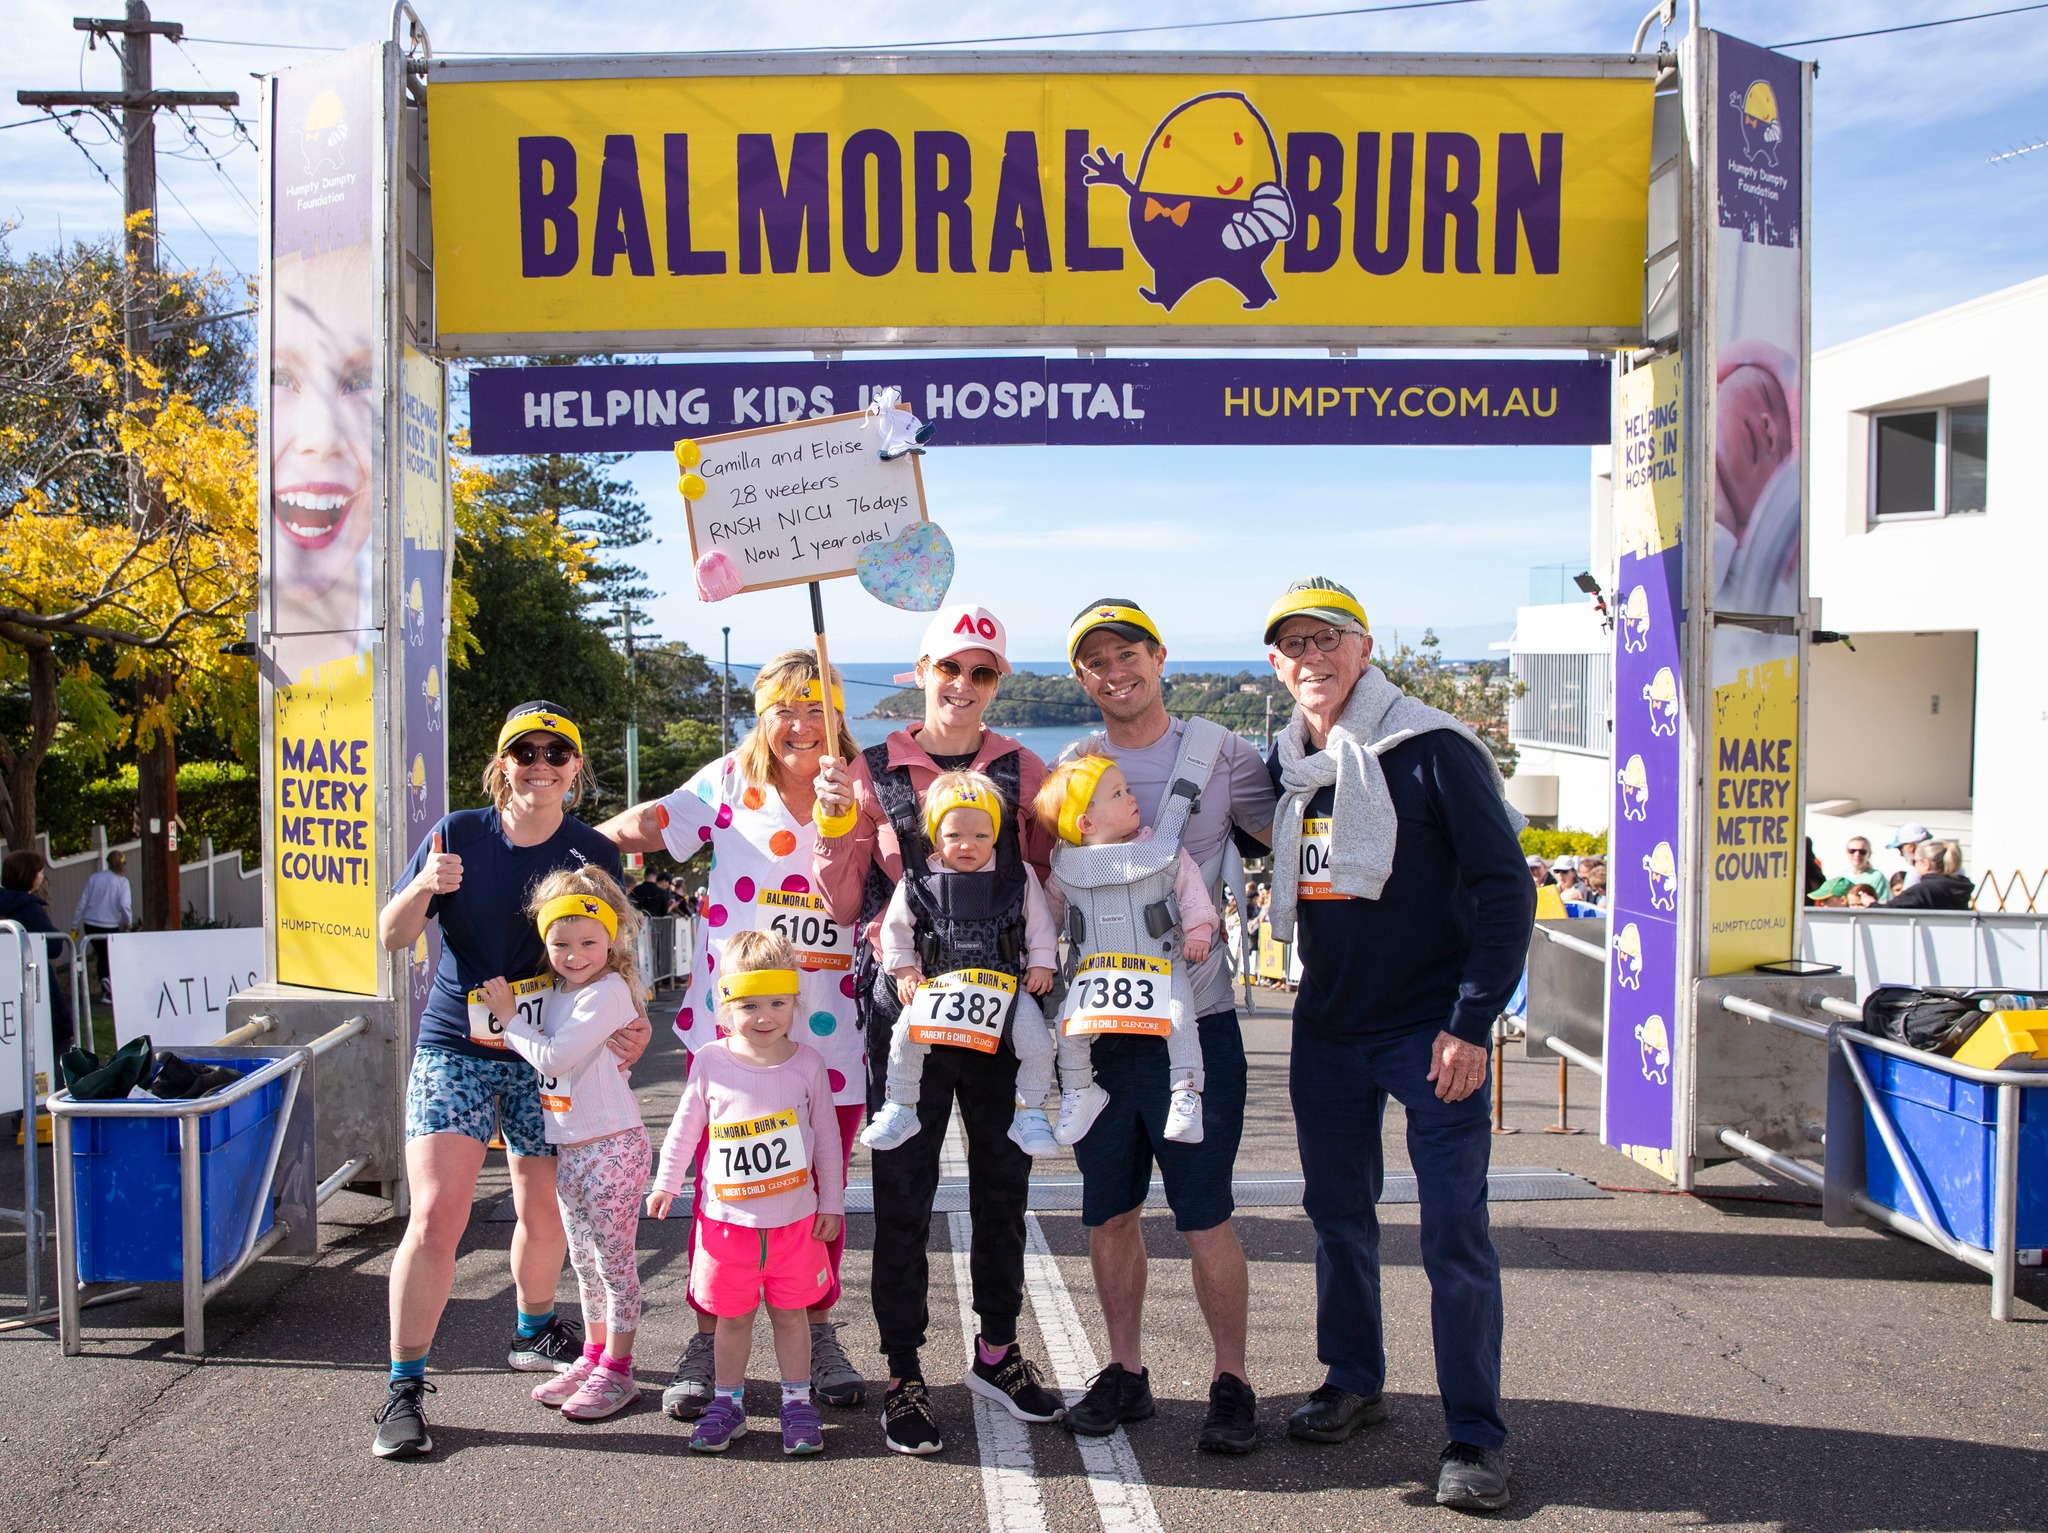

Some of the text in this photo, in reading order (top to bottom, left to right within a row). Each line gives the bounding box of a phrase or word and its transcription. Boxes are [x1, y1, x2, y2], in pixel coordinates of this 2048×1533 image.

[286, 173, 357, 198] Humpty Dumpty
[1728, 158, 1788, 190] Humpty Dumpty
[1737, 178, 1779, 201] Foundation
[297, 191, 345, 211] Foundation
[518, 127, 1563, 277] BALMORAL BURN
[406, 392, 438, 433] HELPING
[523, 387, 710, 428] HELPING
[733, 384, 835, 425] KIDS
[925, 380, 1146, 422] HOSPITAL
[1224, 386, 1558, 418] HUMPTY.COM.AU
[1625, 400, 1678, 440] HELPING
[406, 420, 438, 461] KIDS IN
[1625, 428, 1678, 469] KIDS IN
[406, 449, 438, 484] HOSPITAL
[700, 440, 864, 478] Camilla and Eloise
[1625, 457, 1678, 490] HOSPITAL
[730, 474, 839, 509] 28 weekers
[709, 516, 762, 545] RNSH
[777, 504, 832, 530] NICU
[744, 546, 780, 564] Now
[790, 535, 805, 561] 1
[810, 535, 849, 560] year
[282, 737, 369, 776] MAKE
[1719, 736, 1793, 774] MAKE
[282, 777, 369, 813] EVERY
[1717, 778, 1791, 810] EVERY
[282, 814, 369, 851] METRE
[1311, 822, 1329, 834] BURN
[1716, 815, 1790, 847] METRE
[281, 851, 369, 887] COUNT!
[1715, 851, 1788, 882] COUNT!
[766, 892, 811, 909] BALMORAL
[281, 917, 370, 939] HUMPTY.COM.AU
[770, 914, 838, 948] 6105
[1712, 917, 1786, 935] HUMPTY.COM.AU
[809, 955, 842, 966] GLENCORE
[1121, 956, 1146, 971] BURN
[520, 979, 539, 994] BURN
[977, 972, 1000, 988] BURN
[1078, 977, 1154, 1010] 7383
[488, 997, 544, 1034] 607
[929, 991, 1002, 1029] 7382
[1098, 1019, 1118, 1029] CHILD
[1121, 1021, 1159, 1031] GLENCORE
[920, 1030, 946, 1040] PARENT
[947, 1031, 953, 1041] &
[953, 1032, 972, 1044] CHILD
[714, 1117, 777, 1139] BALMORAL BURN
[719, 1137, 791, 1178] 7402
[722, 1187, 742, 1197] PARENT
[748, 1184, 766, 1195] CHILD
[768, 1175, 800, 1190] GLENCORE
